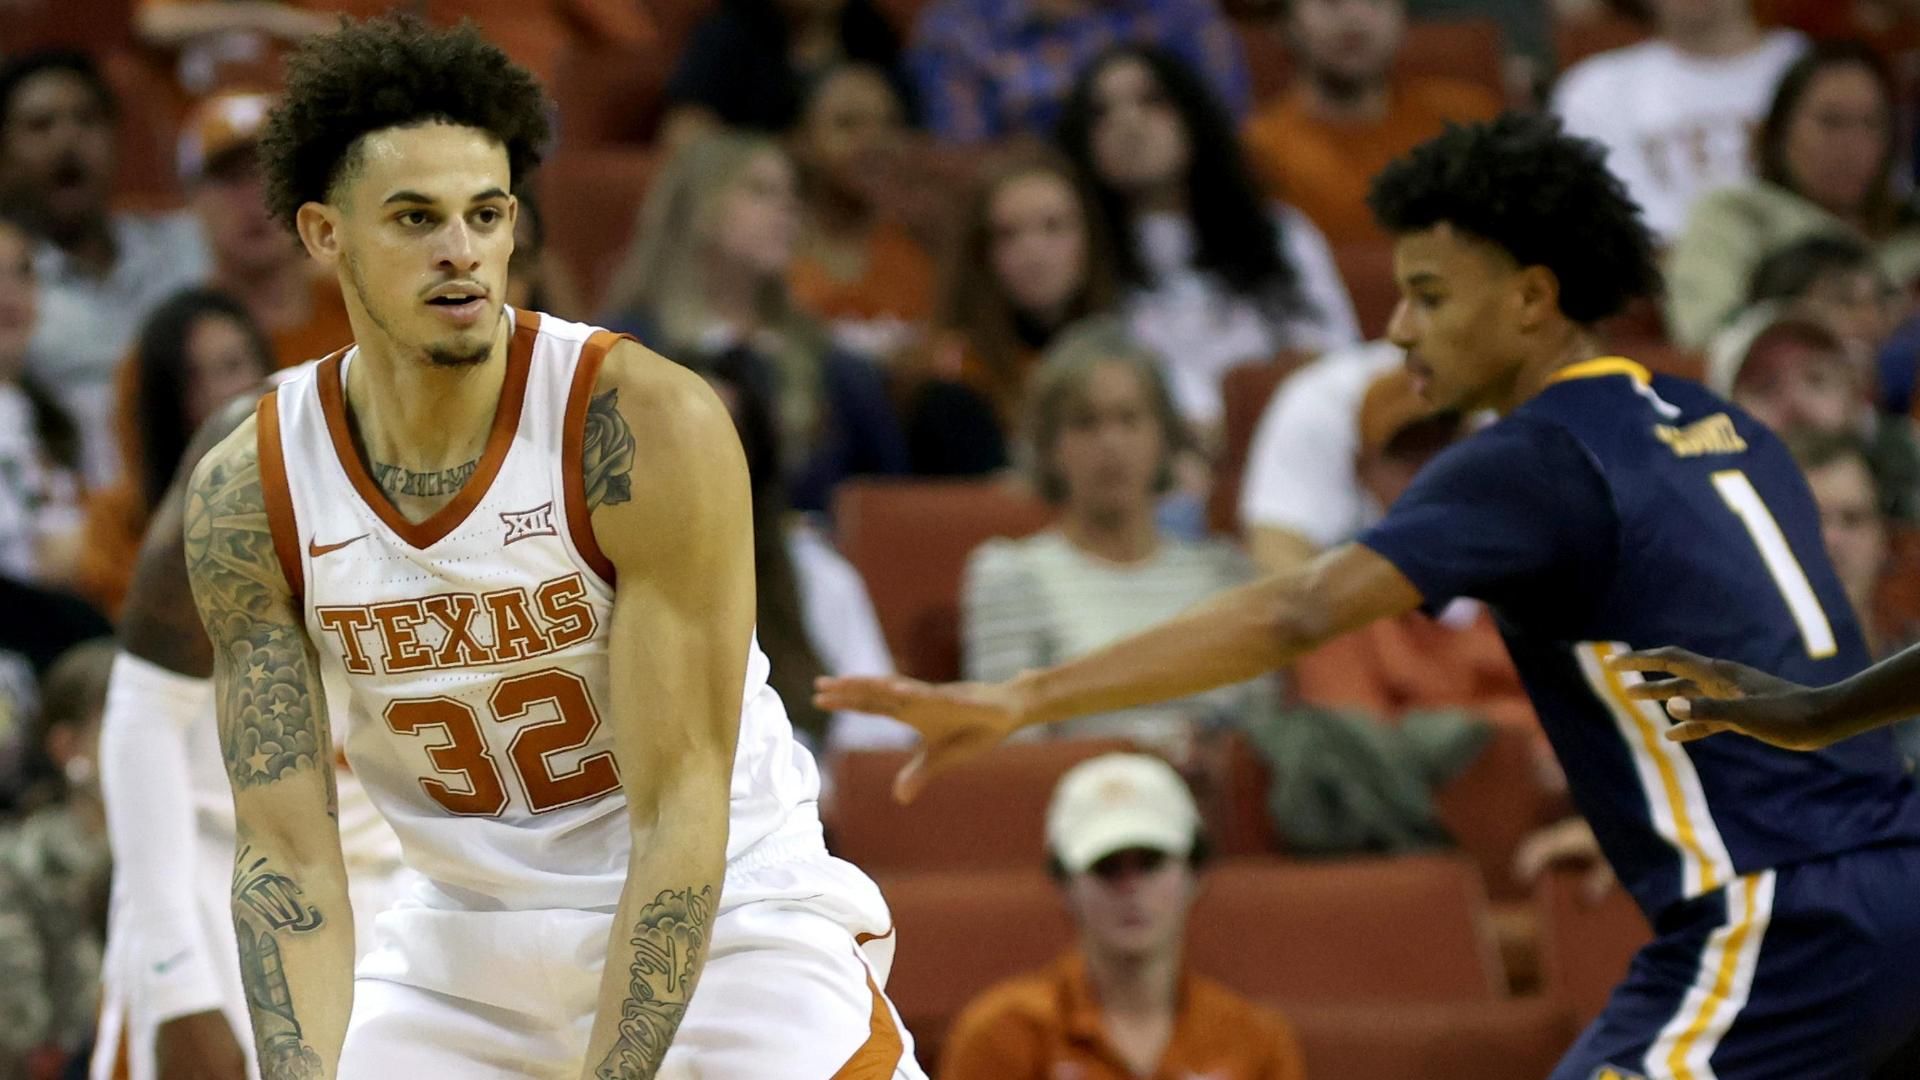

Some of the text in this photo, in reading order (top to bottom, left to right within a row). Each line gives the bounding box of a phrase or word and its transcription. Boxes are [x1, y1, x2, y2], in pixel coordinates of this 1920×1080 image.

[499, 501, 558, 546] XII
[1712, 469, 1837, 660] 1
[315, 572, 598, 674] TEXAS
[383, 667, 622, 817] 32
